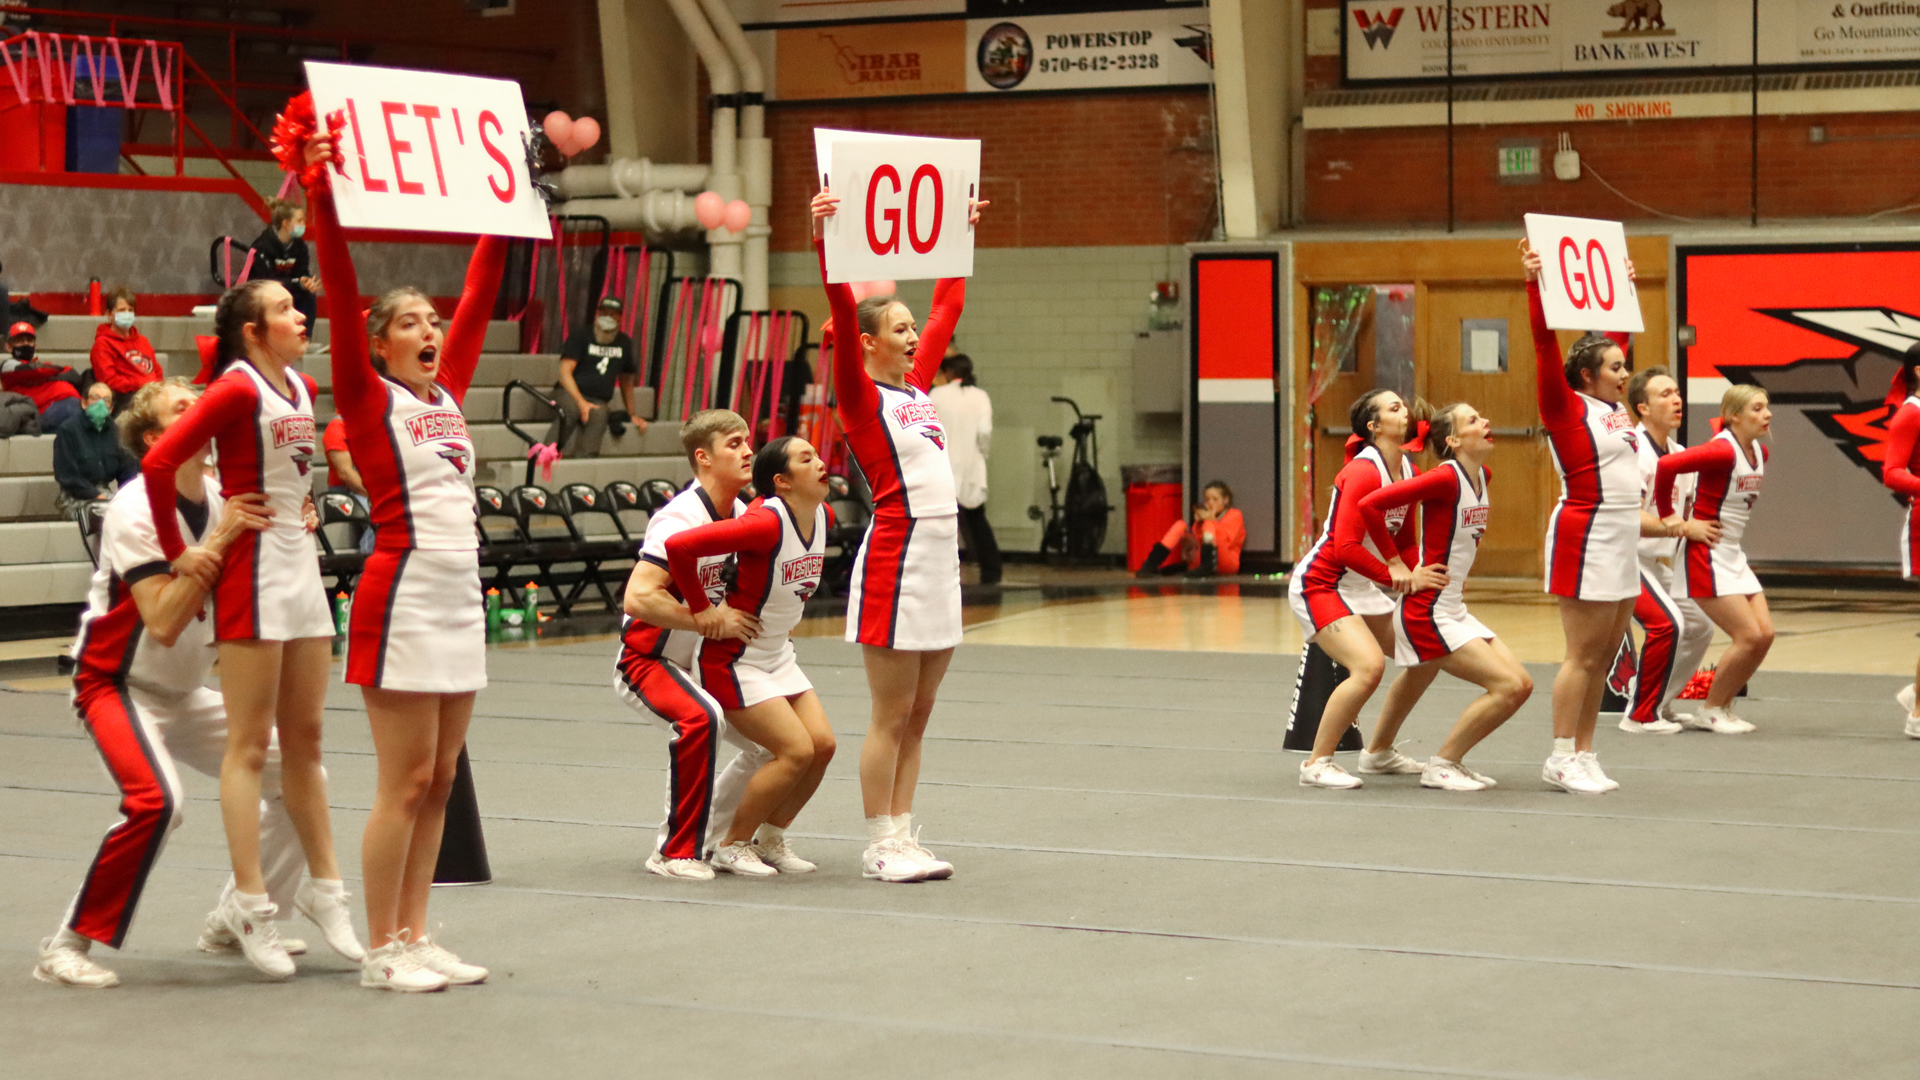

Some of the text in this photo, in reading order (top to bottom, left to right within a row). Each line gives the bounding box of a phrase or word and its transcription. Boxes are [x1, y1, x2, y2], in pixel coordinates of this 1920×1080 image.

[1415, 3, 1550, 32] WESTERN
[1832, 4, 1845, 17] &
[1046, 31, 1153, 49] POWERSTOP
[1814, 26, 1835, 40] Go
[1575, 43, 1626, 60] BANK
[1646, 40, 1701, 58] WEST
[1040, 53, 1159, 72] 970-642-2328
[859, 68, 922, 82] RANCH
[1575, 101, 1672, 119] NO SMOKING
[345, 98, 516, 204] LET'S
[1506, 149, 1532, 172] EXIT
[865, 163, 944, 256] GO
[1559, 236, 1615, 311] GO
